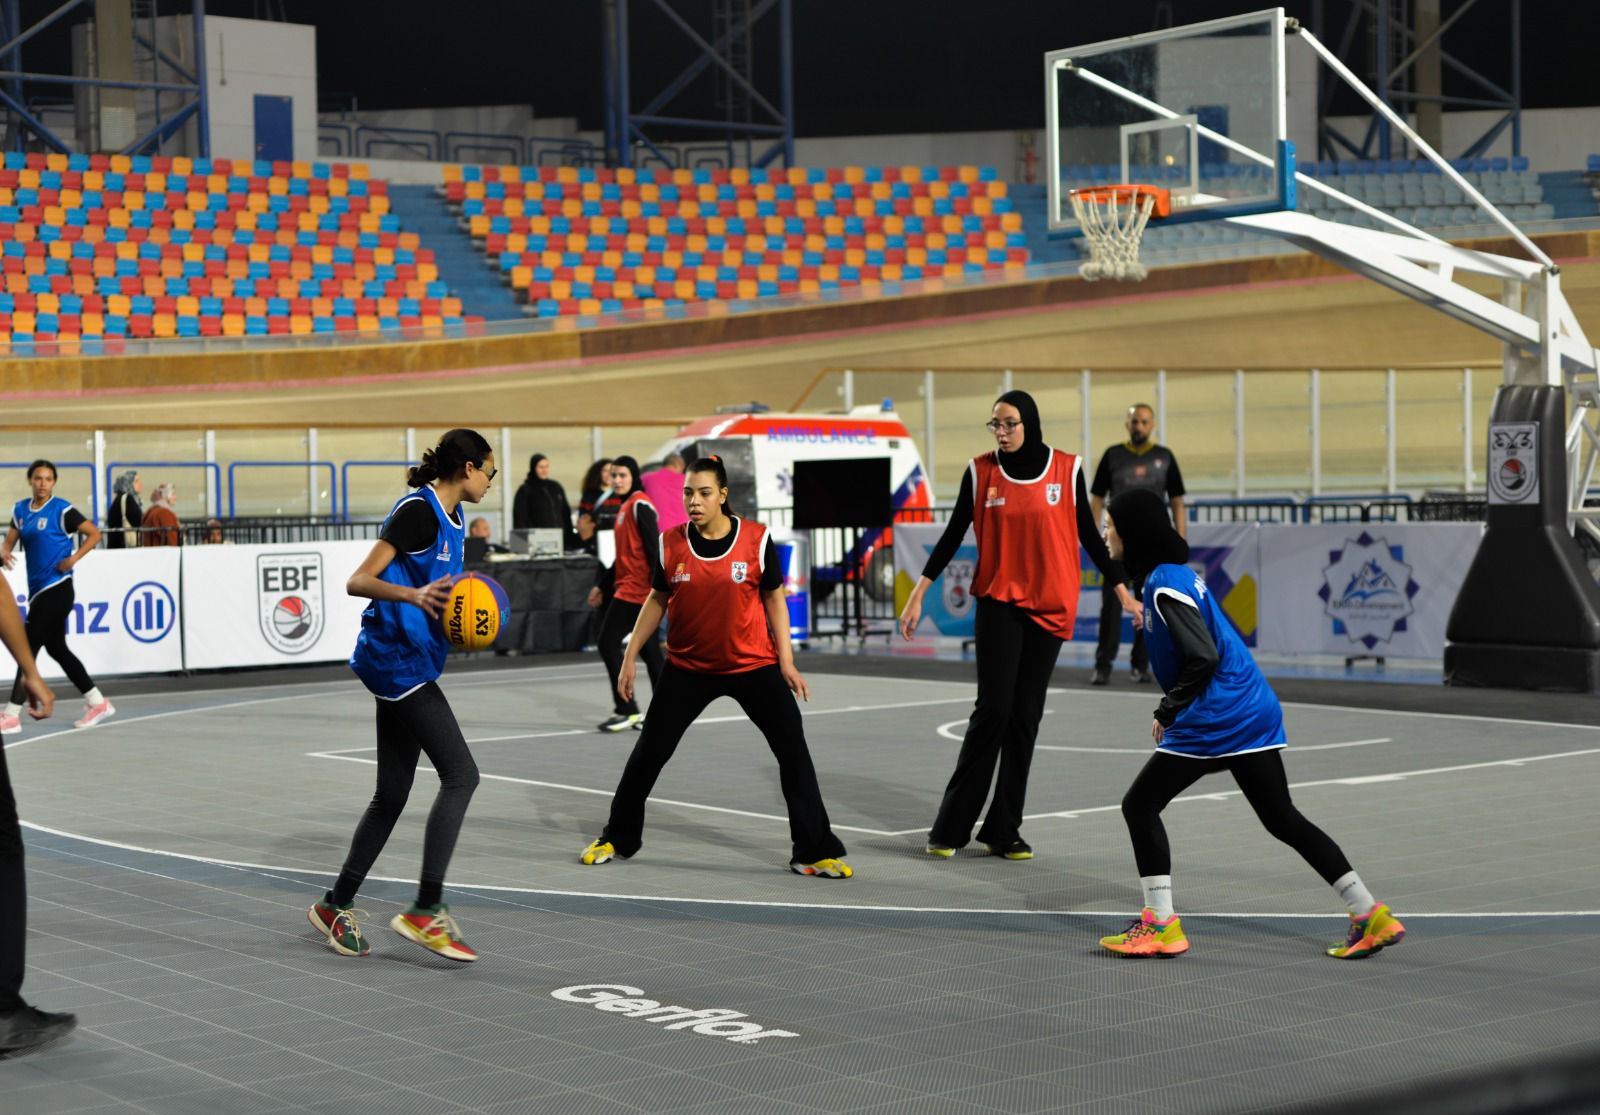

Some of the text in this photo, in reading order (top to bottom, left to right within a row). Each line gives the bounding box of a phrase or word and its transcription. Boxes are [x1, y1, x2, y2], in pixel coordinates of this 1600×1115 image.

[767, 425, 877, 445] AMBULANCE
[262, 565, 318, 593] EBF
[448, 596, 465, 644] Wilson
[550, 983, 801, 1044] Gerflor
